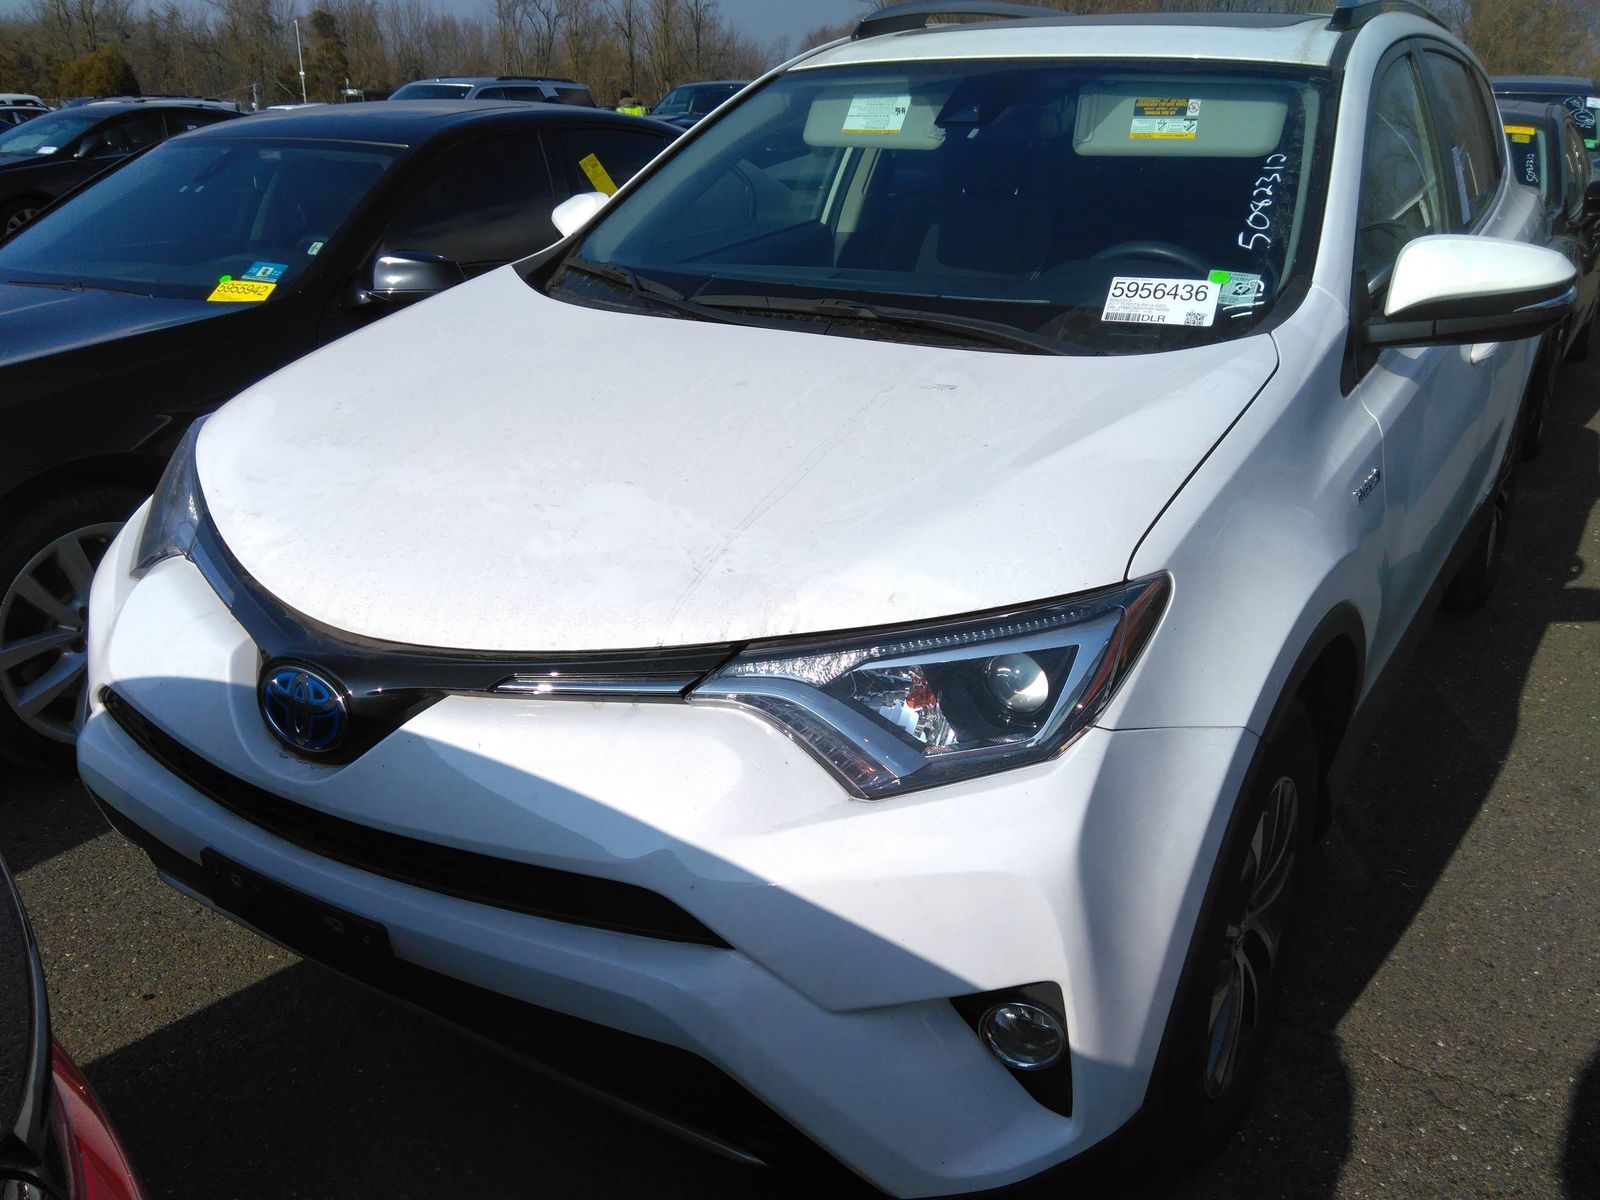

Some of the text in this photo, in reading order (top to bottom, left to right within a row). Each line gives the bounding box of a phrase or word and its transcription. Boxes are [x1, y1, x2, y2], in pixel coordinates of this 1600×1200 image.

[217, 282, 269, 296] 5955942
[1111, 281, 1209, 302] 5956436
[1140, 314, 1166, 323] DLR
